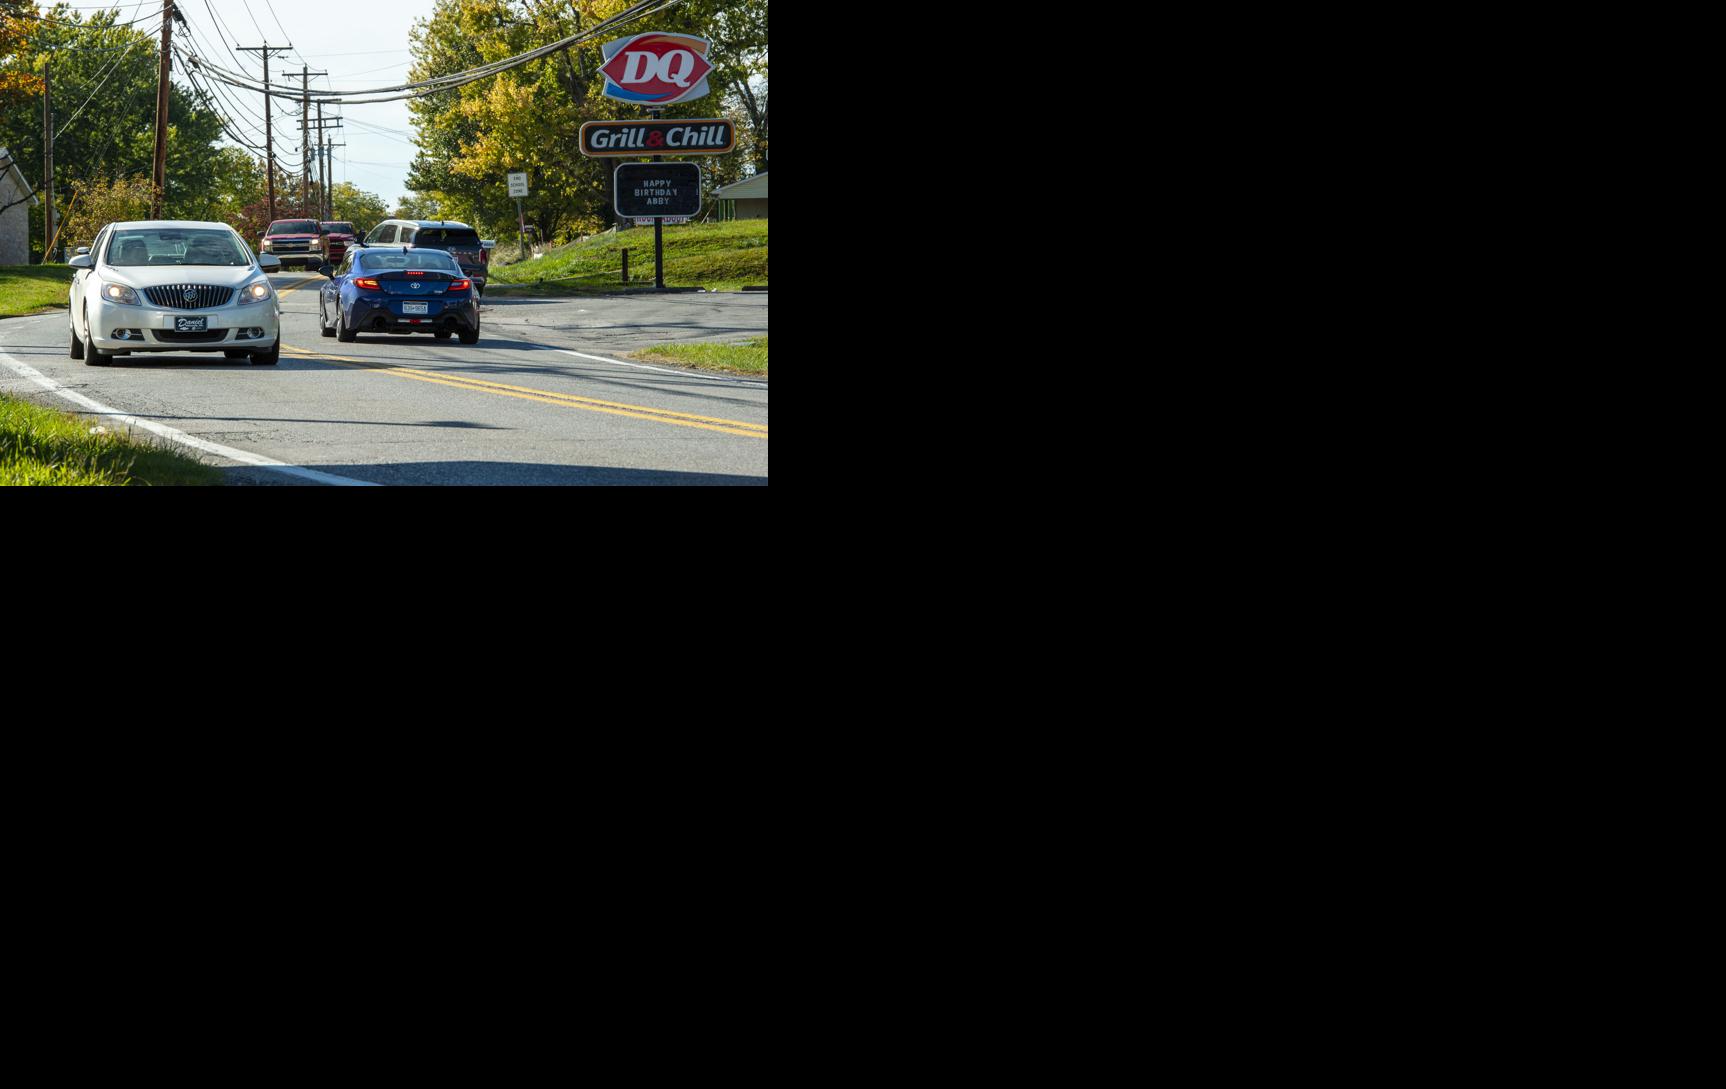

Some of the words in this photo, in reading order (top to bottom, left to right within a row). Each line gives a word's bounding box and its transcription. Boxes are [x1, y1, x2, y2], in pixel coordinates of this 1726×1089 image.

[621, 50, 695, 88] DQ
[634, 188, 678, 196] BIRTHDAY
[178, 318, 204, 327] Daniel
